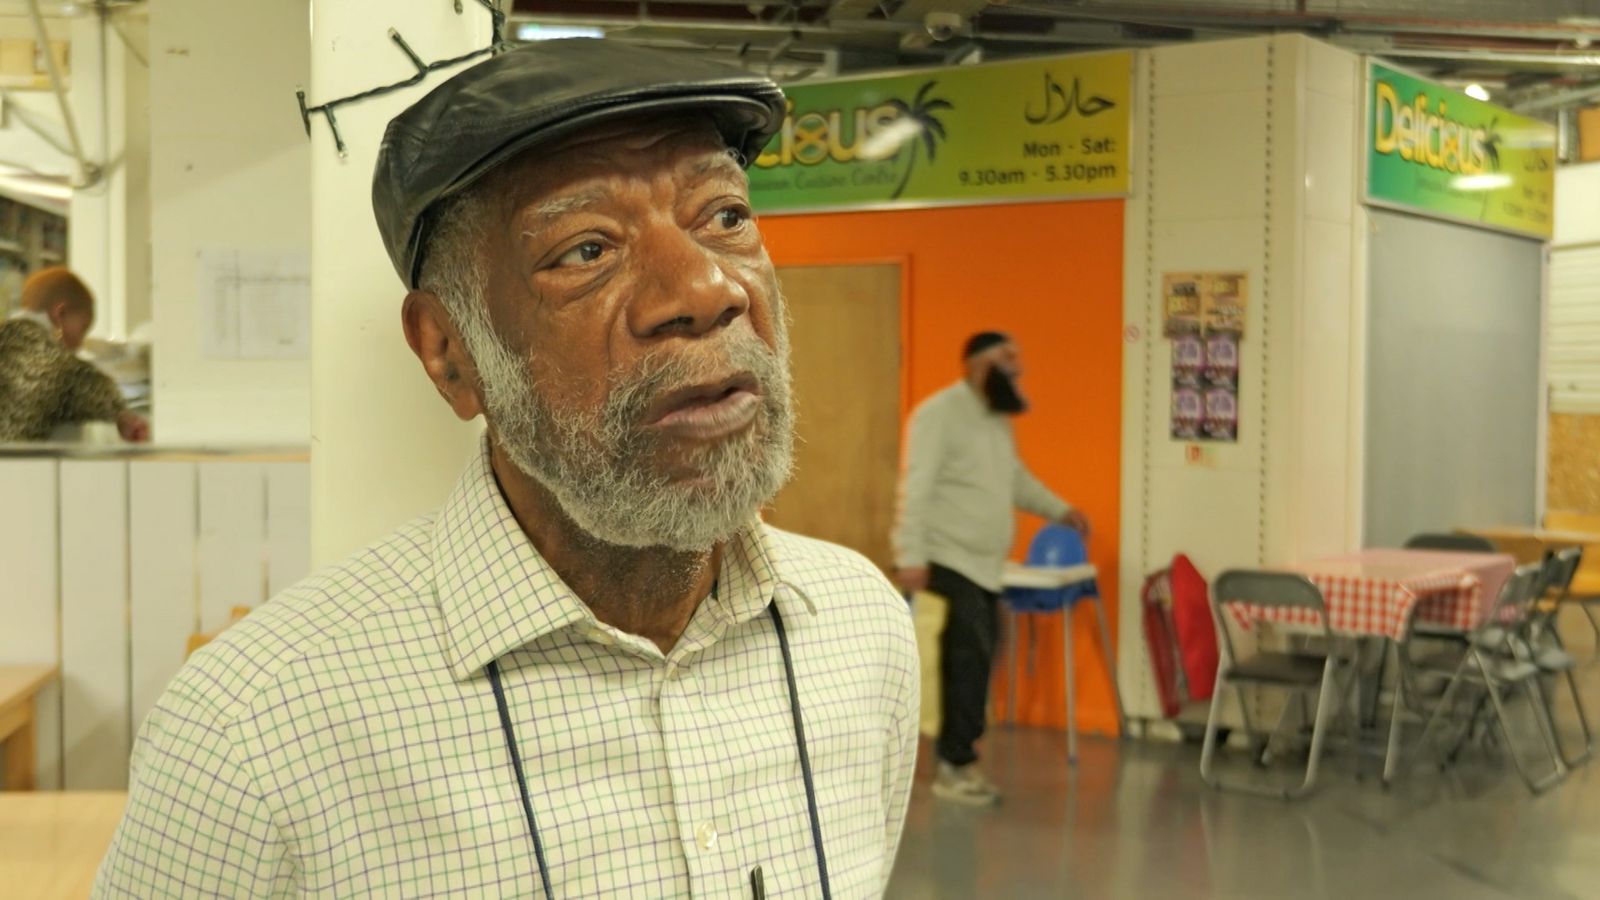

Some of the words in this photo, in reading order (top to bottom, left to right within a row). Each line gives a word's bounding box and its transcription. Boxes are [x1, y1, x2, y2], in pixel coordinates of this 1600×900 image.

[1024, 71, 1116, 125] حلال
[1375, 80, 1487, 175] Delicious
[1023, 142, 1061, 158] Mon
[1081, 138, 1116, 156] Sat:
[958, 168, 1025, 187] 9.30am
[1045, 163, 1117, 183] 5.30pm
